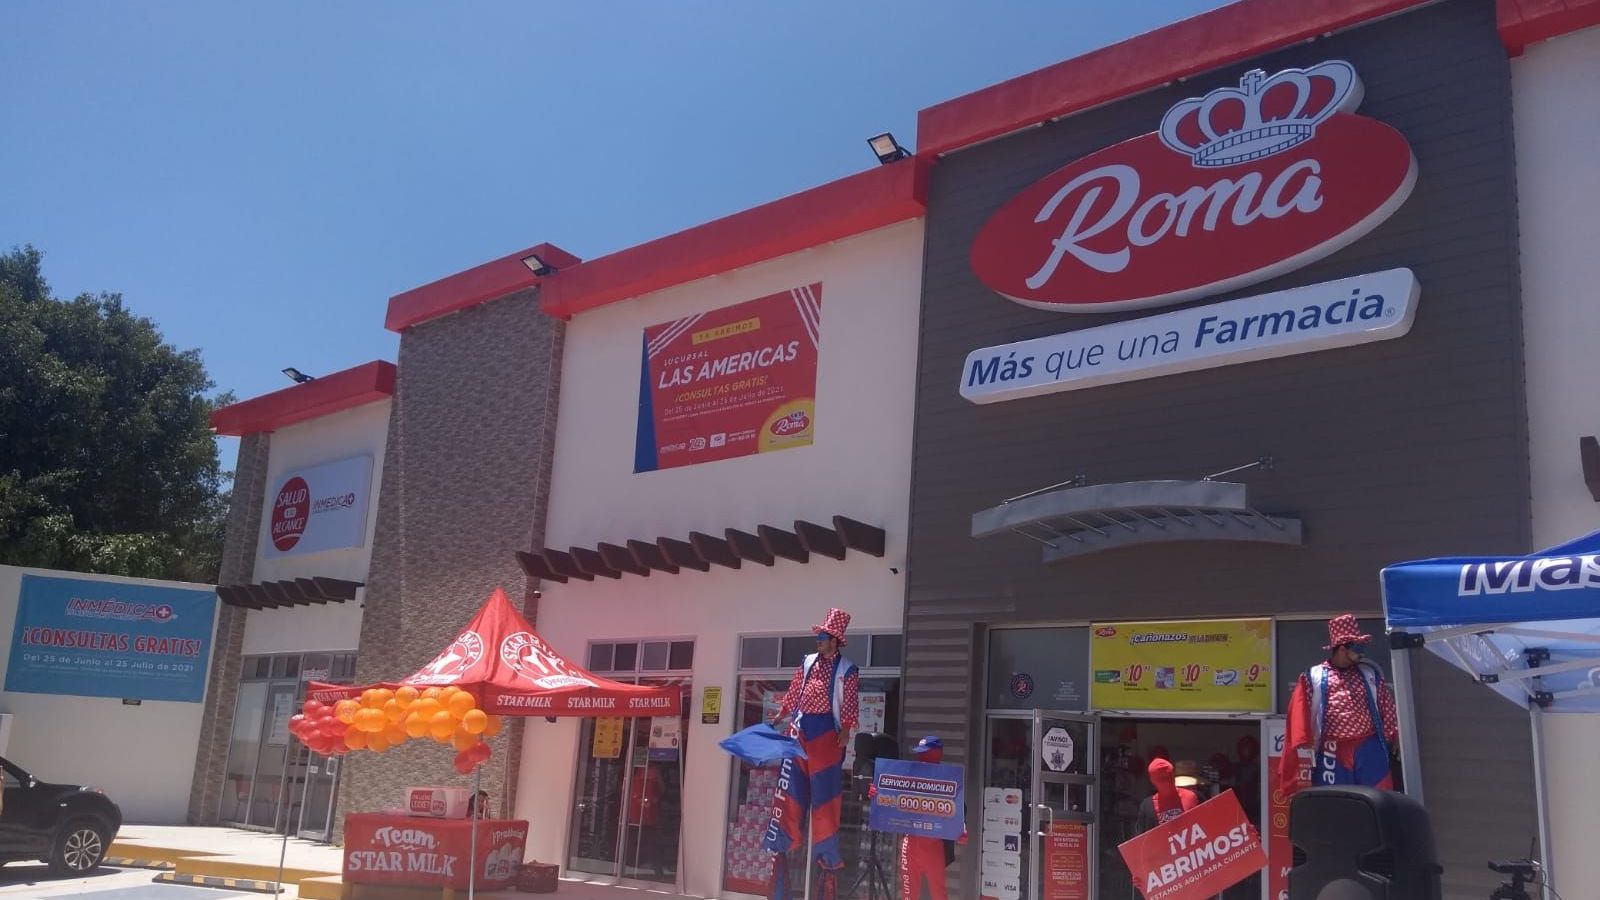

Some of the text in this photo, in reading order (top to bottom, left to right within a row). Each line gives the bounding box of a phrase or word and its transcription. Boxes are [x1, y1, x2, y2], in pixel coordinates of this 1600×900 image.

[1025, 158, 1324, 290] Roma
[968, 288, 1386, 387] Más que una Farmacia
[658, 340, 799, 390] LAS AMERICAS
[664, 351, 709, 367] SUCURSAL
[775, 418, 805, 435] Roma
[277, 488, 306, 508] SALUD
[22, 626, 201, 657] ¡CONSULTAS GRATIS!
[23, 653, 194, 673] Del 25 de Junio al 25 Julio de 2021
[496, 694, 553, 708] STAR MILK
[567, 696, 616, 709] STAR MILK
[629, 697, 671, 709] STAR MILK
[880, 777, 955, 794] SERVICIO A DOMICILIO
[900, 797, 920, 810] 900
[920, 799, 936, 812] 90
[936, 800, 952, 814] 90
[375, 826, 436, 850] Team
[1167, 822, 1207, 856] ¡YA
[348, 851, 458, 877] STAR MILK
[1146, 822, 1250, 894] ABRIMOS!
[1204, 861, 1223, 877] PARA
[1224, 842, 1258, 866] CUIDARTE
